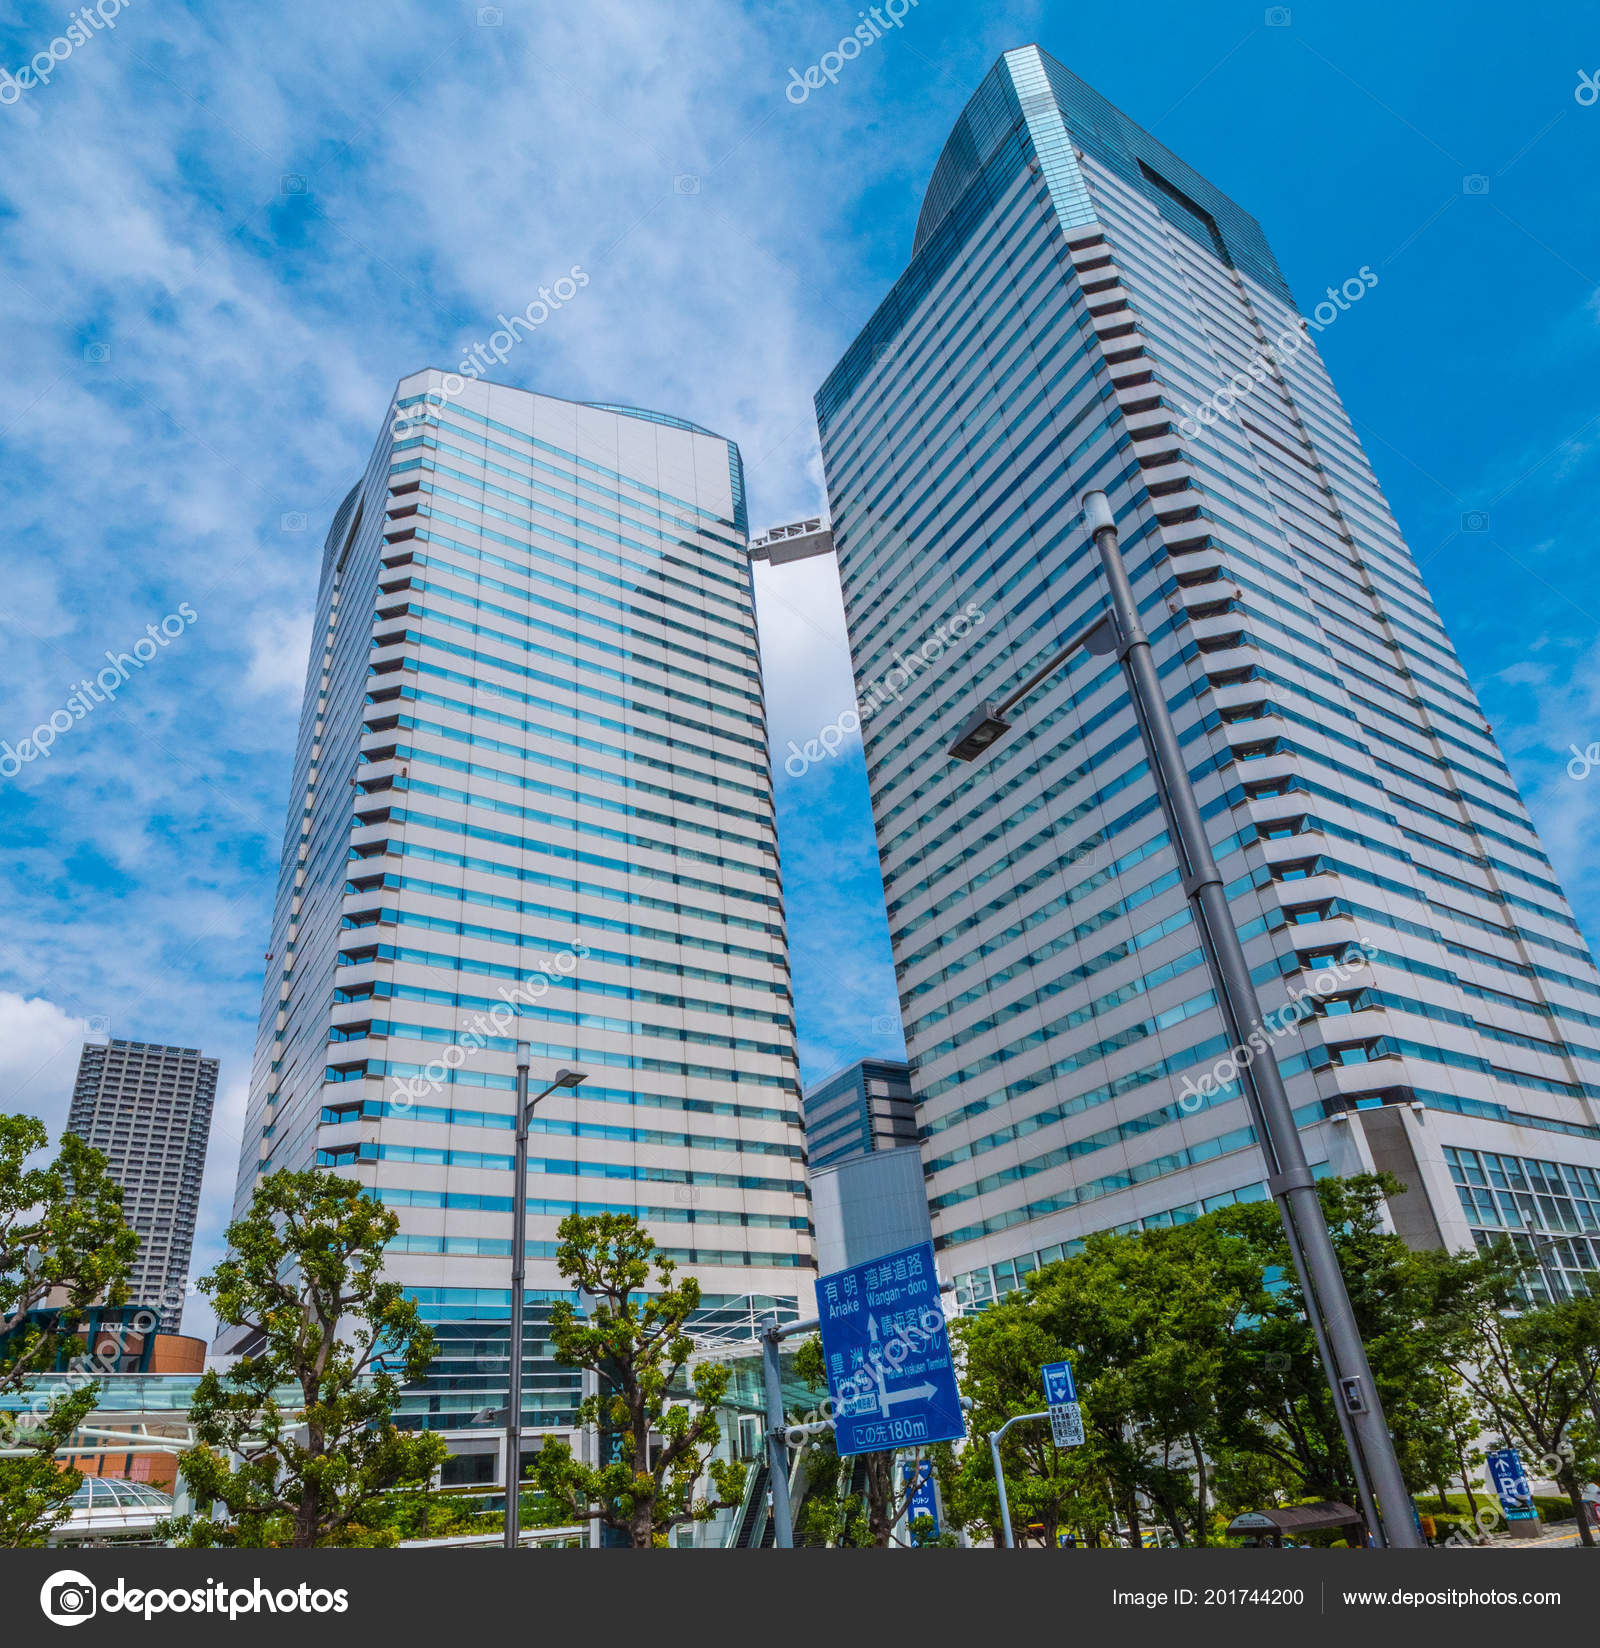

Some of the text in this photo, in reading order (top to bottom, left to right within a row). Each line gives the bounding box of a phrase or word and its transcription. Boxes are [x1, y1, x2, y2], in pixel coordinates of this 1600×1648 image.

[824, 1253, 923, 1303] 有明 湾岸道路
[829, 1299, 860, 1320] Ariake
[911, 1497, 930, 1505] トリトン
